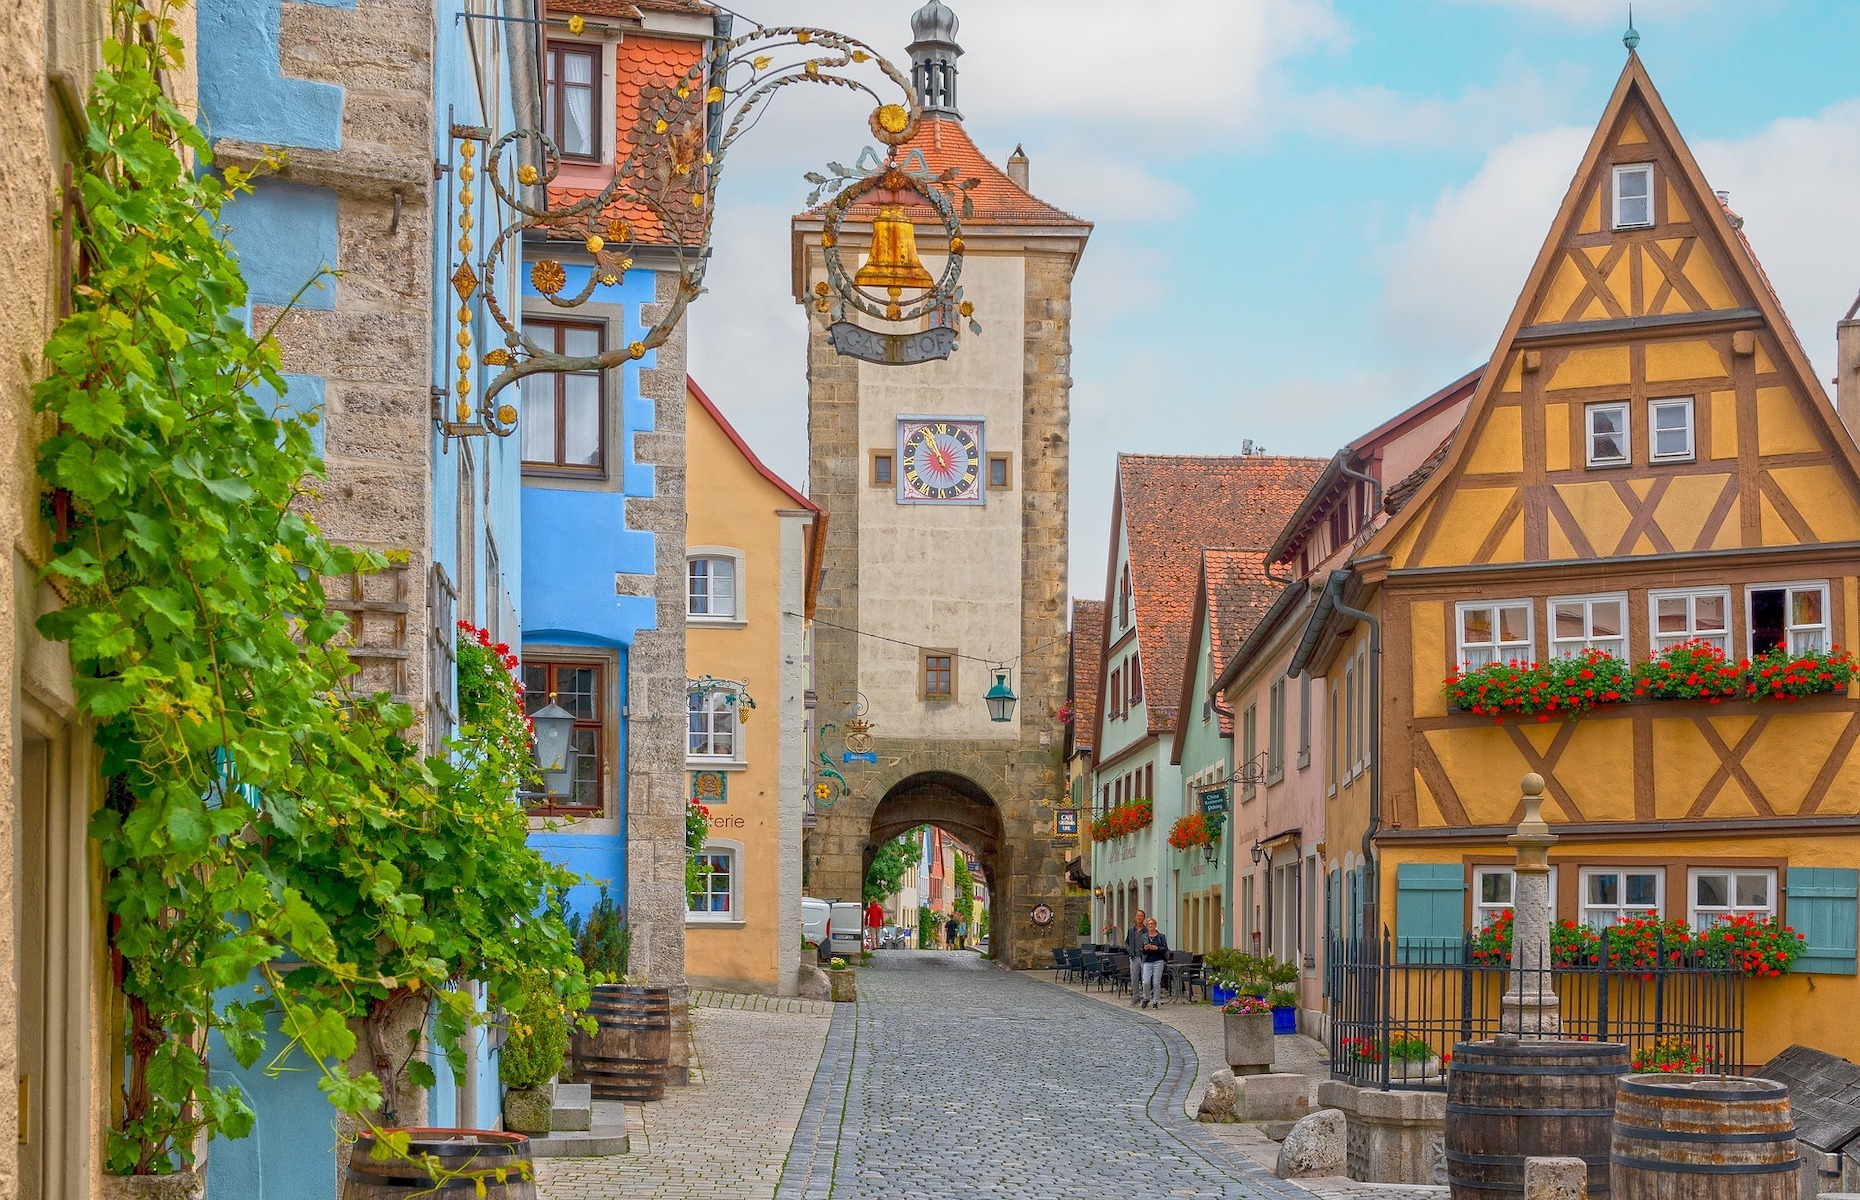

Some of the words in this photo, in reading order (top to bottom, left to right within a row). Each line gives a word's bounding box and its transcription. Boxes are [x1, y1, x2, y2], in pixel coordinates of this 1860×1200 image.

[844, 329, 946, 358] GASTHOF
[964, 441, 975, 450] II
[967, 458, 978, 466] III
[954, 485, 963, 496] V
[708, 814, 745, 828] terie
